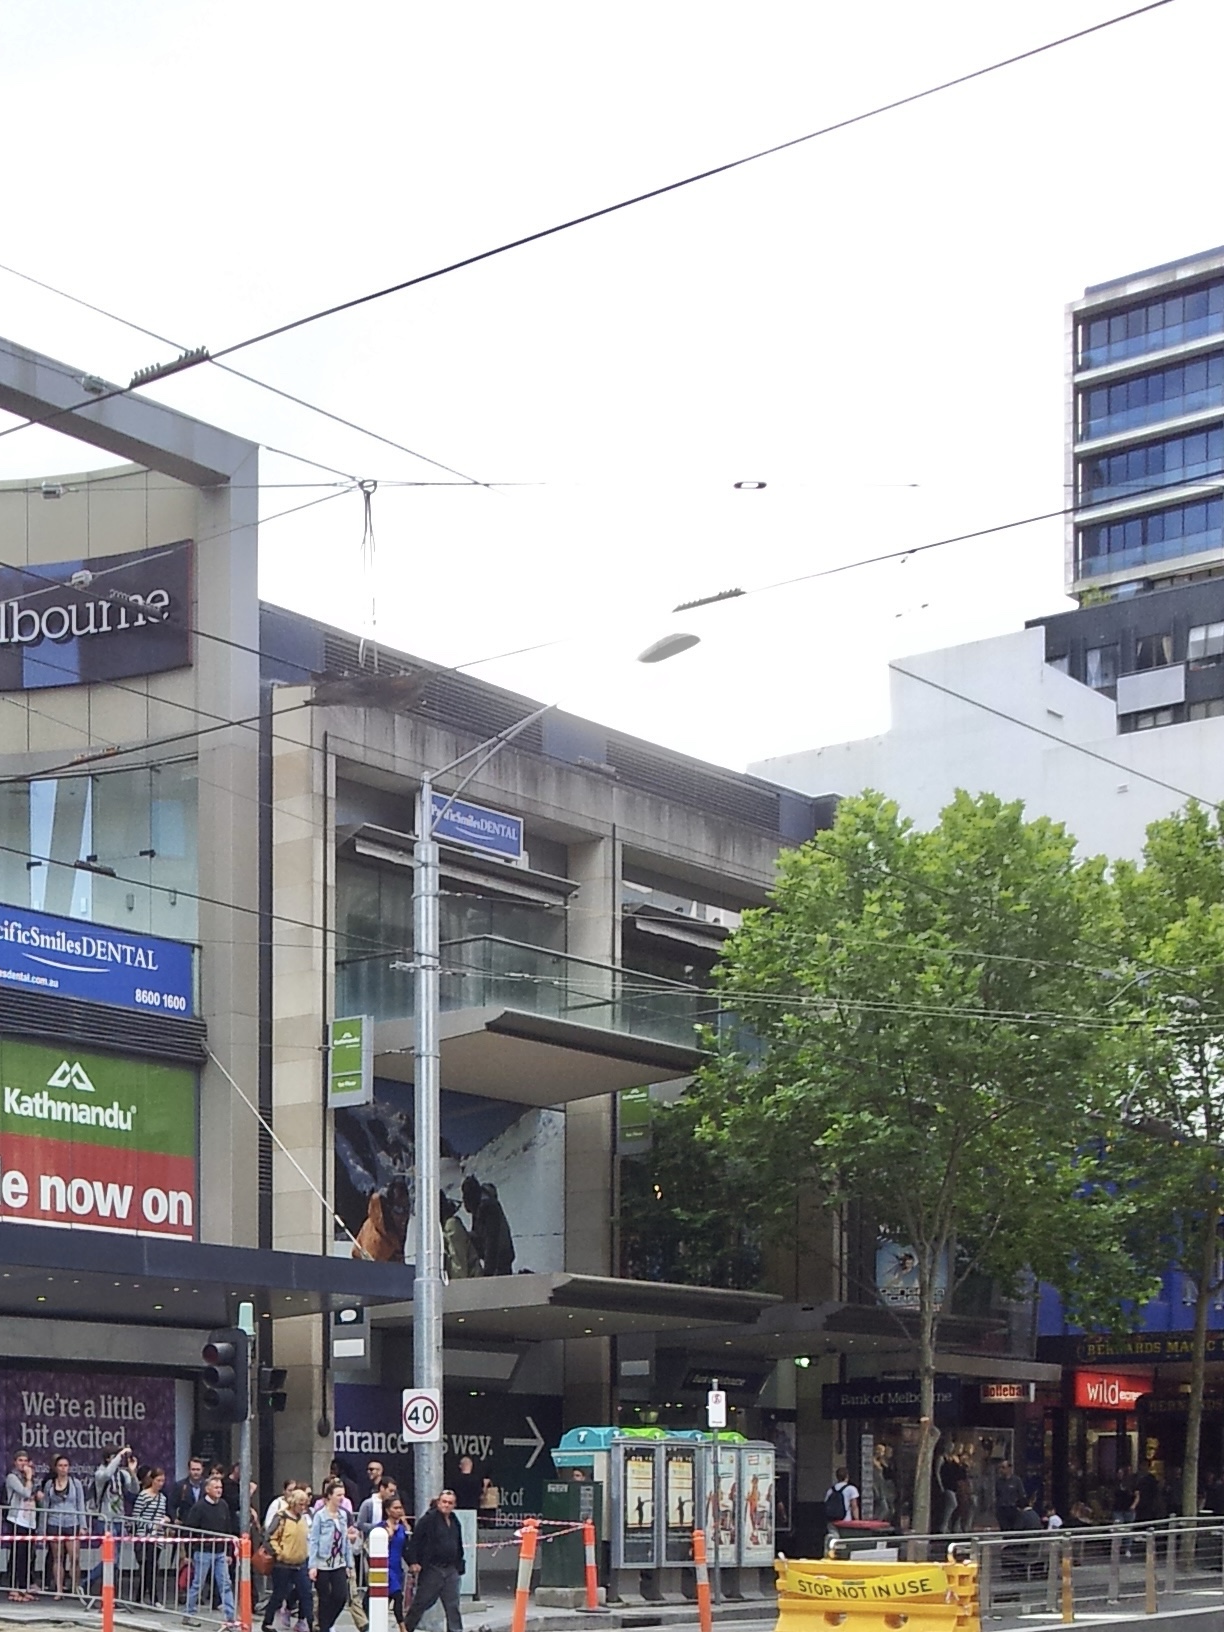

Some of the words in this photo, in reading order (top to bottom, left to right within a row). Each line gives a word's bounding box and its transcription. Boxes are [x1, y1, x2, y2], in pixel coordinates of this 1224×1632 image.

[135, 988, 161, 1006] 8600
[162, 993, 186, 1011] 1600
[4, 1086, 133, 1131] Kathmandu
[39, 1174, 133, 1219] now
[142, 1187, 193, 1226] on
[1087, 1341, 1161, 1356] BERARDS
[841, 1393, 870, 1405] Bank
[872, 1392, 885, 1404] of
[888, 1391, 952, 1404] Melborne
[1086, 1378, 1119, 1405] wild
[21, 1391, 81, 1418] We're
[84, 1399, 96, 1418] a
[100, 1394, 146, 1420] little
[407, 1405, 434, 1425] 40
[21, 1422, 49, 1448] bit
[333, 1425, 409, 1453] ntrance
[452, 1436, 494, 1461] way.
[511, 1487, 525, 1507] of
[798, 1579, 833, 1596] STOP
[836, 1586, 867, 1599] NOT
[871, 1585, 891, 1598] IN
[894, 1578, 933, 1596] USE
